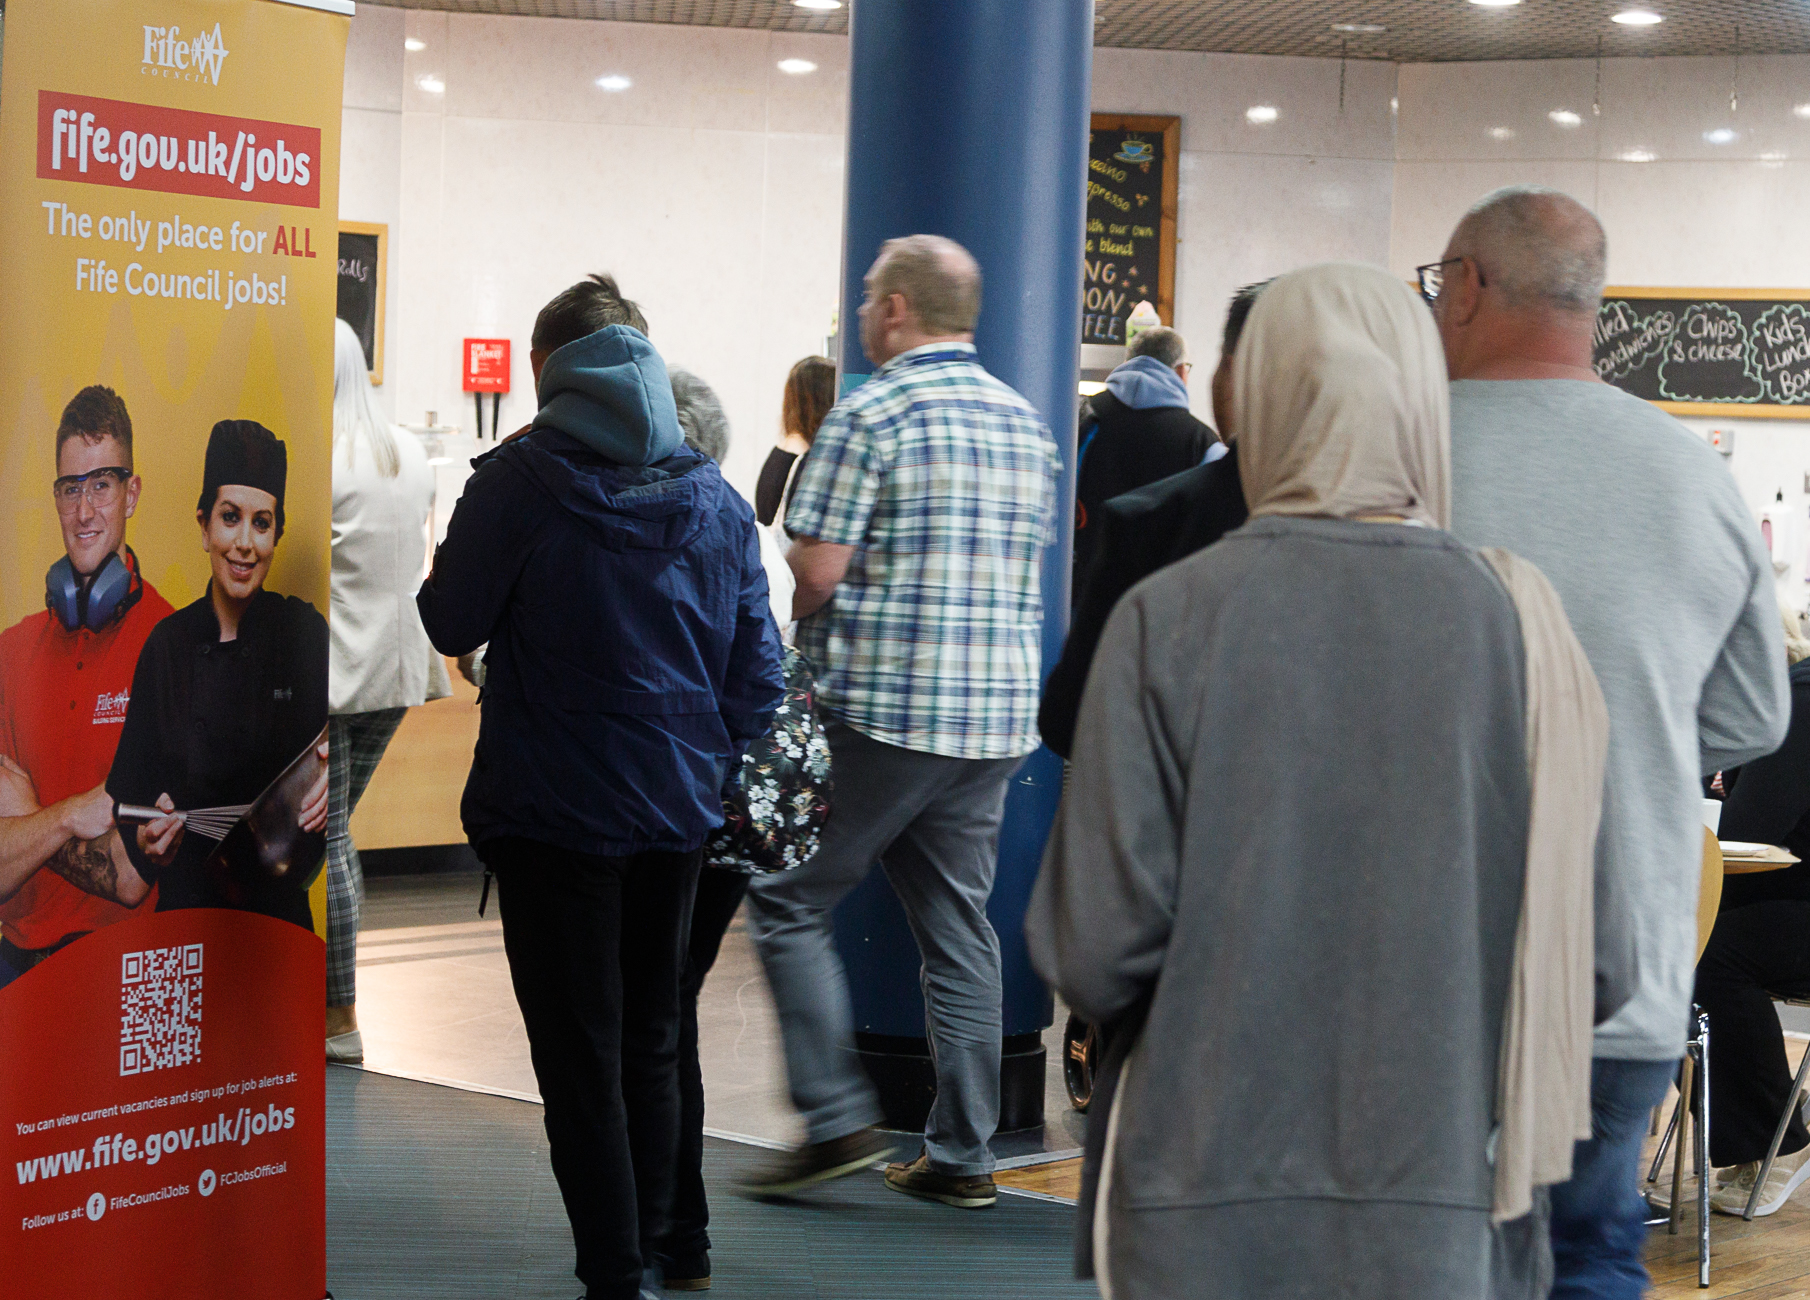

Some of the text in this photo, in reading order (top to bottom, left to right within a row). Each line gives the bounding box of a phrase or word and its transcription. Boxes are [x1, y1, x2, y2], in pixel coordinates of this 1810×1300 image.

[142, 25, 190, 70] Fife
[141, 66, 208, 84] COUNCIL
[52, 108, 311, 192] fife.gov.uk/jobs
[42, 201, 317, 258] The only place for ALL
[1099, 237, 1134, 257] blend
[76, 258, 287, 310] Fife Council jobs!
[1687, 313, 1737, 344] Chips
[1688, 338, 1743, 362] cheese
[1763, 313, 1806, 349] Kids
[16, 1071, 298, 1136] You can view current vacancies and sign up for job alerts at:
[16, 1103, 295, 1184] www.fife.gov.uk/jobs
[21, 1214, 56, 1230] Follow
[57, 1211, 69, 1222] us
[70, 1206, 84, 1219] at:
[110, 1183, 190, 1211] FifeCouncilJobs
[220, 1161, 287, 1187] FCJobsOfficial
